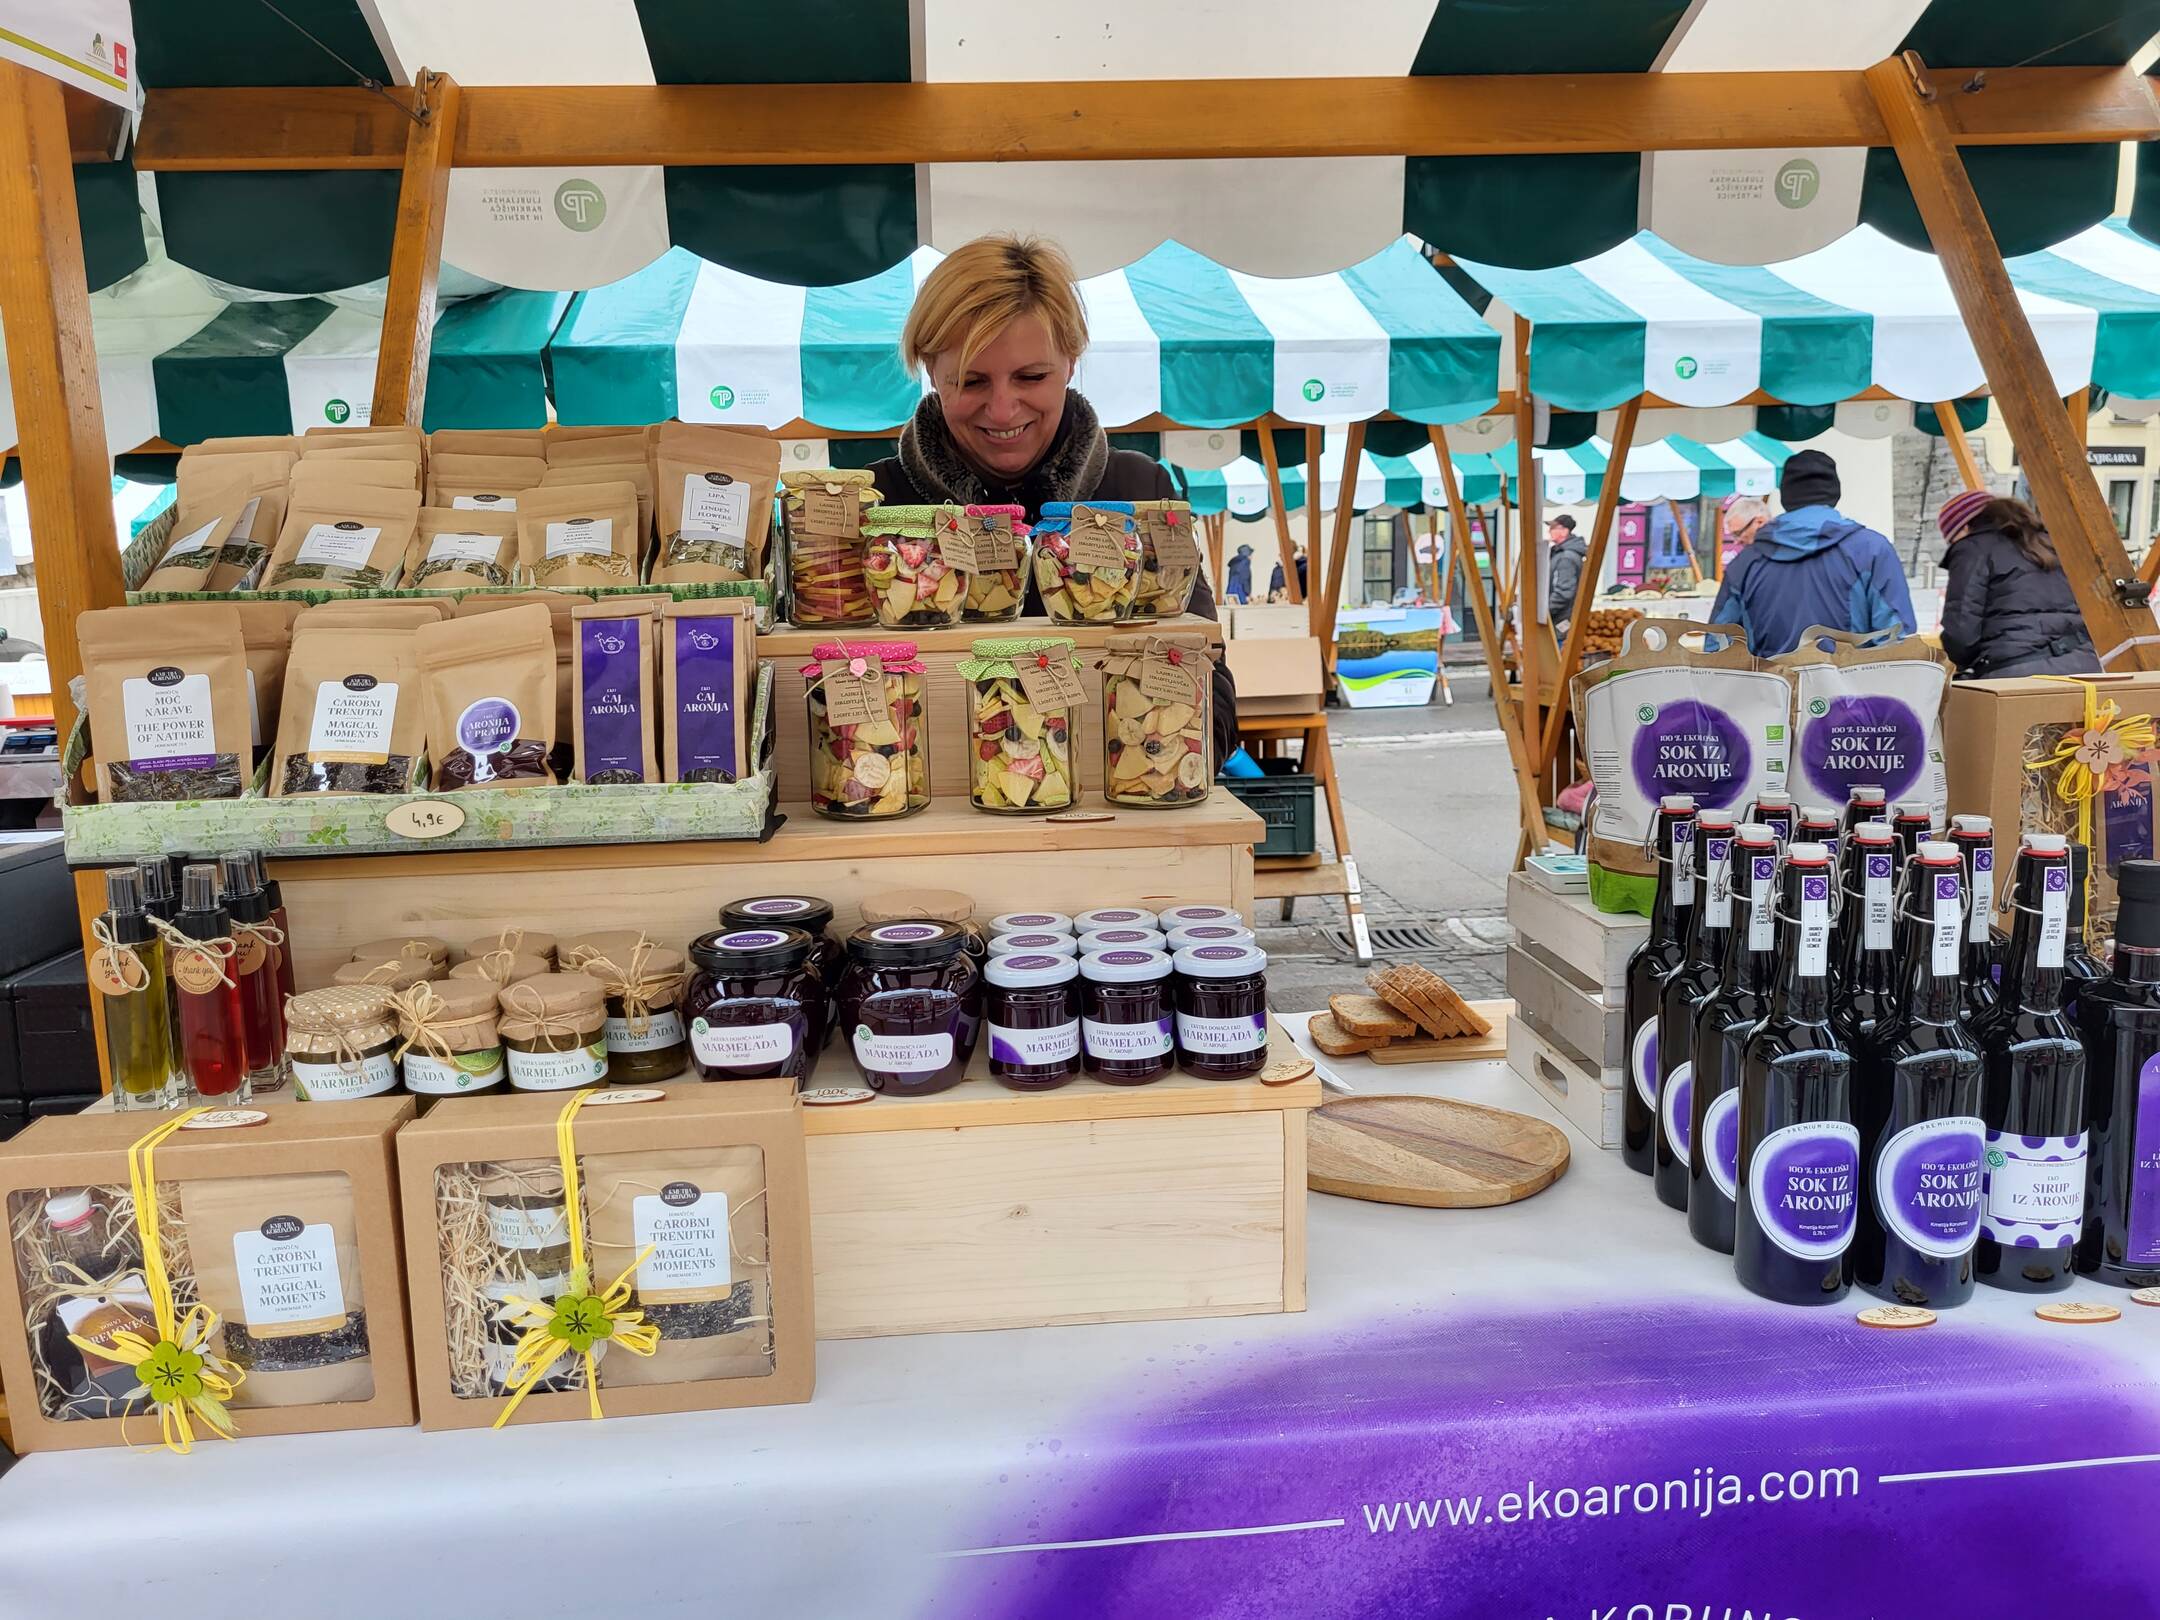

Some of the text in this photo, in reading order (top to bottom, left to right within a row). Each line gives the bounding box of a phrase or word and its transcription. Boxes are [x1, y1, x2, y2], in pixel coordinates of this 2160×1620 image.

[155, 696, 181, 705] MOC
[145, 705, 193, 717] NARAVE
[328, 707, 383, 717] TRENUTKI
[590, 704, 635, 715] ARONIJA
[683, 702, 729, 714] ARONIJA
[134, 720, 205, 733] THE POWER
[328, 721, 378, 730] MAGICAL
[467, 717, 510, 730] ARONIJA
[137, 730, 205, 743] OF NATURE
[324, 730, 380, 739] MOMENTS
[474, 726, 511, 737] PRAHU
[1831, 736, 1896, 751] SOK IZ
[1660, 745, 1721, 760] SOK IZ
[1823, 754, 1905, 773] ARONIJE
[1653, 763, 1732, 782] ARONIJE
[412, 812, 444, 828] 4,9€
[1089, 1034, 1158, 1048] MARMELADA
[1183, 1029, 1252, 1042] MARMELADA
[702, 1039, 778, 1052] MARMELADA
[864, 1048, 940, 1060] MARMELADA
[513, 1063, 587, 1079] MARMELADA
[1787, 1124, 1822, 1134] PREMIUM
[1920, 1120, 1956, 1131] PREMIUM
[1988, 1151, 2005, 1165] BIO
[1788, 1165, 1803, 1173] 100
[1804, 1166, 1813, 1174] %
[1921, 1163, 1936, 1171] 100
[1937, 1163, 1946, 1171] %
[1788, 1175, 1848, 1193] SOK IZ
[1920, 1171, 1977, 1189] SOK IZ
[2032, 1182, 2070, 1194] SIRUP
[1780, 1191, 1853, 1214] ARONIJE
[1911, 1187, 1981, 1210] ARONIJE
[2012, 1191, 2081, 1207] IZ ARONIJE
[650, 1229, 716, 1242] TRENUTKI
[655, 1247, 713, 1260] MAGICAL
[253, 1261, 323, 1278] TRENUTKI
[652, 1258, 716, 1272] MOMENTS
[260, 1279, 322, 1295] MAGICAL
[259, 1290, 326, 1308] MOMENTS
[1362, 1464, 1861, 1535] www.ekoaronija.com
